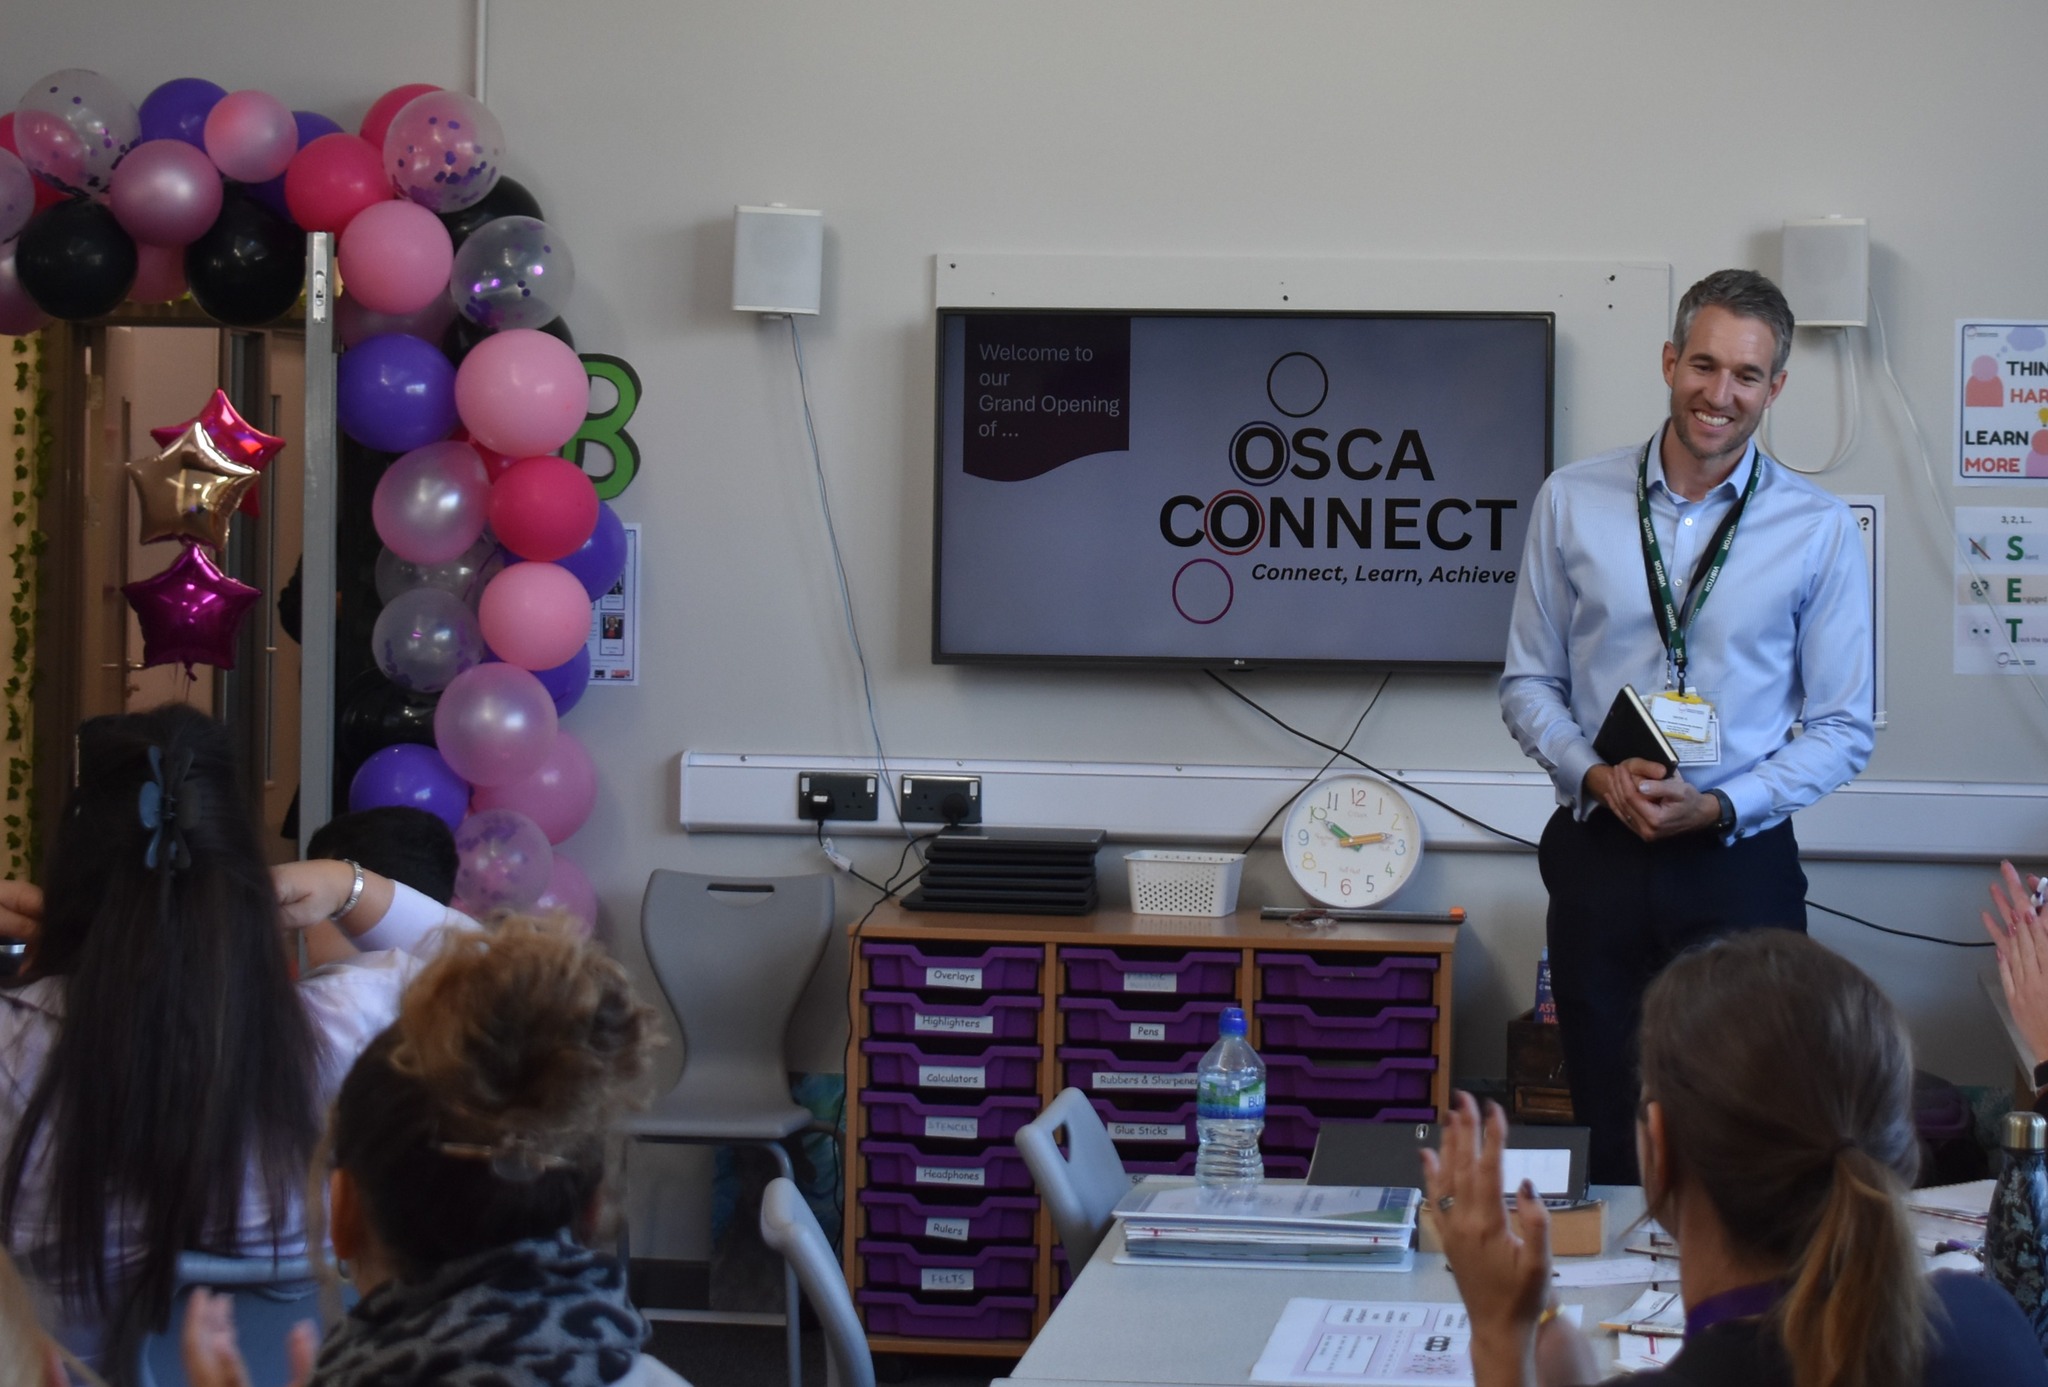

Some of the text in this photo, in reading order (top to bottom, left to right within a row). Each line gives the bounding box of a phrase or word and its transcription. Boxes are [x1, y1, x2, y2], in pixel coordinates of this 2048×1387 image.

[979, 343, 1093, 362] Welcome to
[979, 373, 1010, 386] our
[979, 394, 1120, 418] Grand Opening
[979, 420, 997, 437] of
[1965, 430, 2029, 446] LEARN
[1234, 427, 1435, 481] OSCA
[1964, 457, 2020, 473] MORE
[1159, 494, 1518, 551] CONNECT
[1643, 517, 1655, 545] VISITOR
[1722, 525, 1736, 550] VISITOR
[1251, 563, 1516, 586] Connect, Learn, Achieve
[1654, 560, 1667, 588] VISITOR
[1704, 566, 1720, 592] VISITOR
[1665, 604, 1677, 631] VISITOR
[1327, 791, 1338, 811] 11
[1351, 788, 1366, 807] 12
[1378, 797, 1383, 815] 1
[1391, 813, 1402, 831] 2
[1298, 829, 1309, 846] 9
[1395, 839, 1406, 856] 3
[1302, 851, 1316, 870] 8
[1385, 862, 1395, 877] 4
[1318, 871, 1327, 888] 7
[1340, 878, 1351, 896] 6
[1366, 875, 1375, 893] 5
[934, 970, 975, 983] Overlays
[922, 1015, 980, 1029] Highlighters
[1138, 1025, 1159, 1037] Pens
[927, 1073, 978, 1084] Calculators
[1100, 1075, 1139, 1085] Rubbers
[1141, 1076, 1148, 1085] &
[1115, 1125, 1168, 1136] Glue Sticks
[923, 1168, 980, 1181] Headphones
[933, 1222, 962, 1236] Rulers
